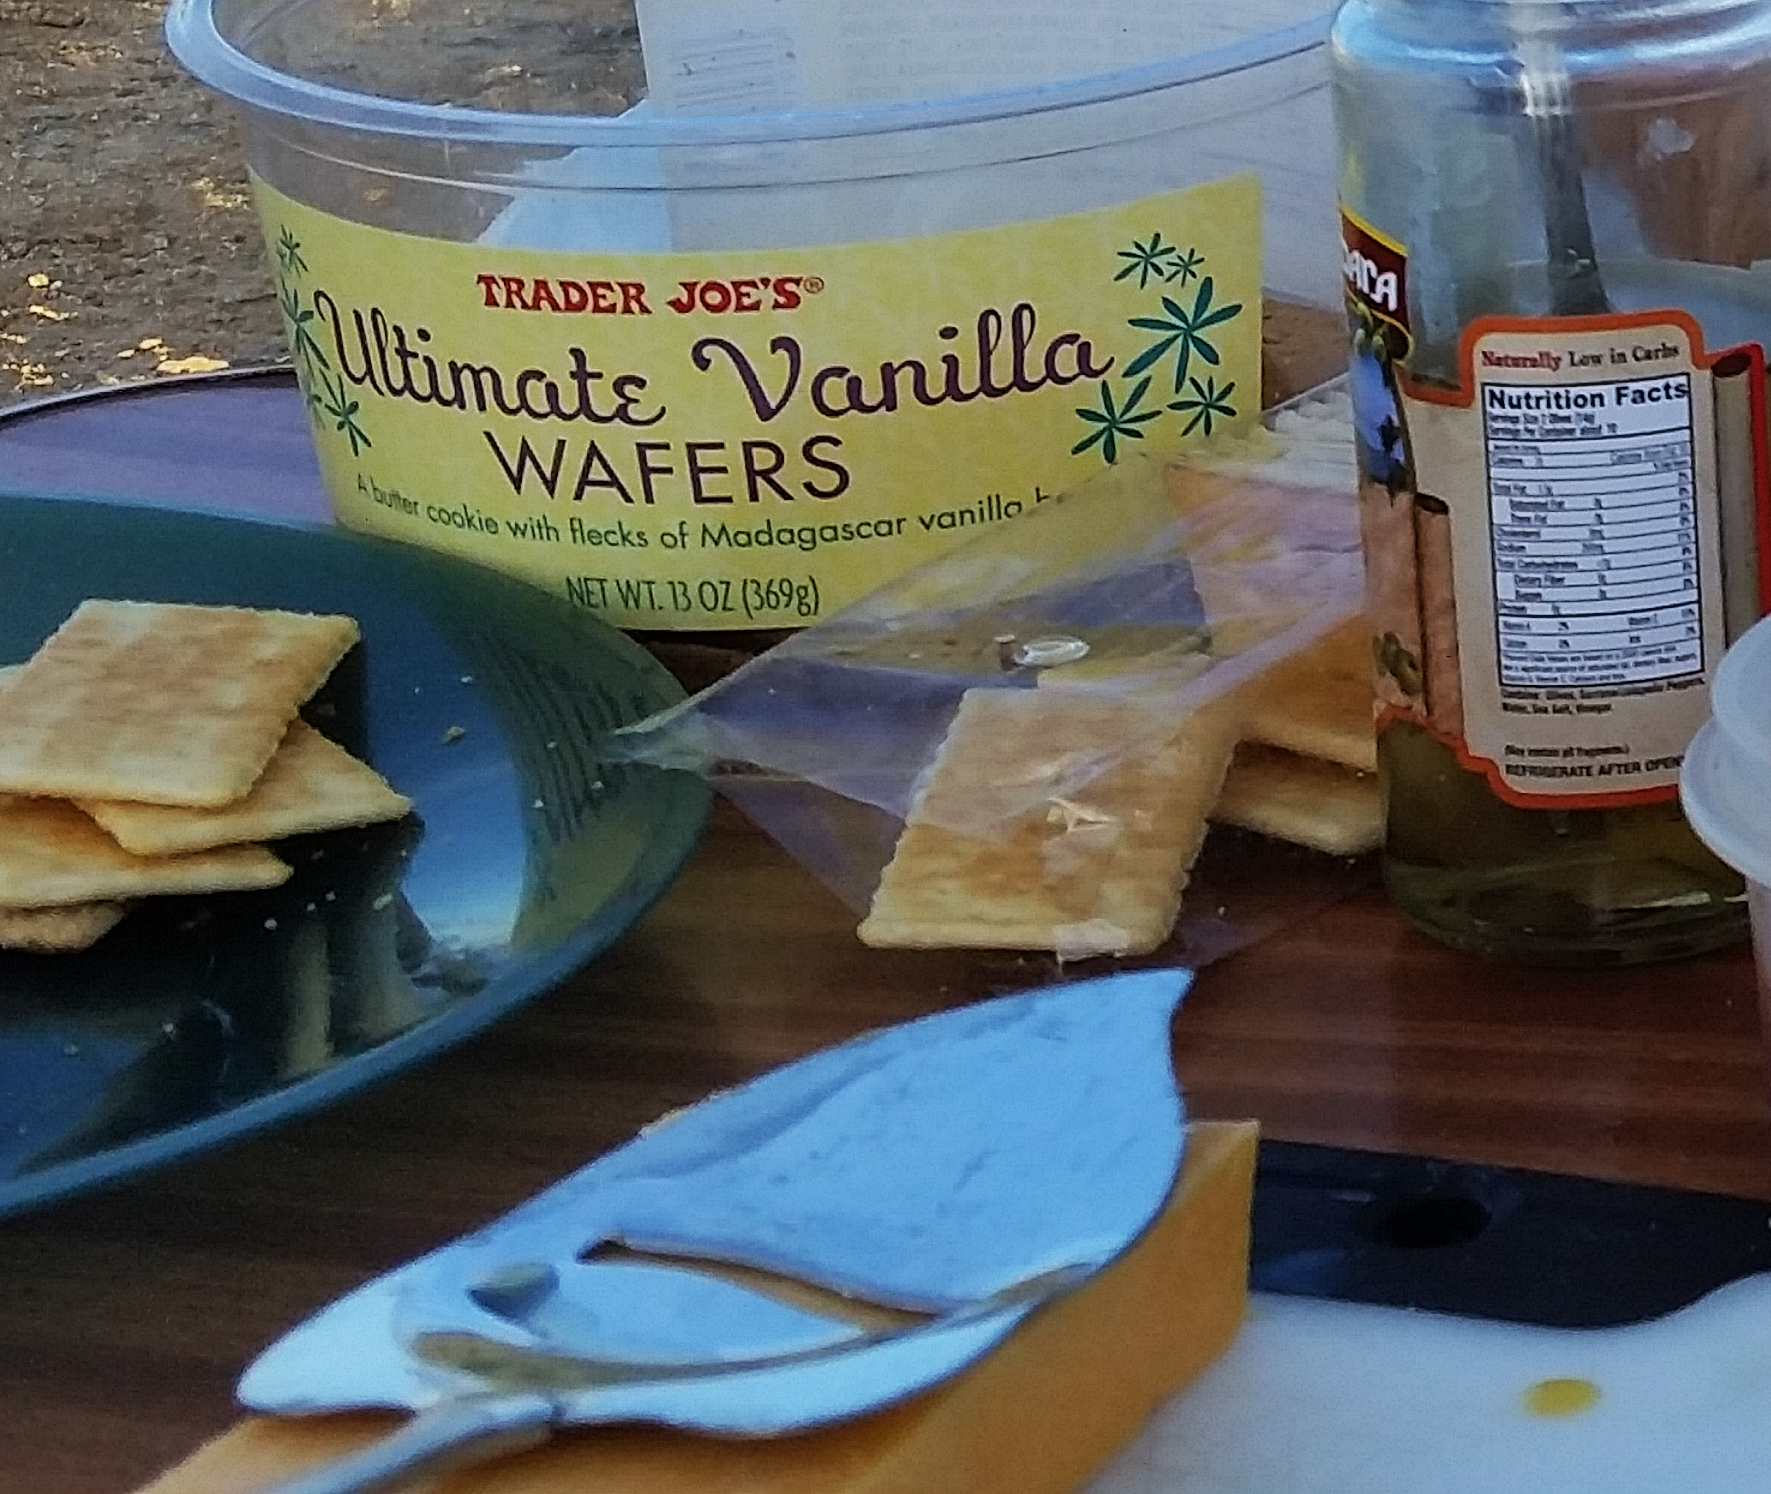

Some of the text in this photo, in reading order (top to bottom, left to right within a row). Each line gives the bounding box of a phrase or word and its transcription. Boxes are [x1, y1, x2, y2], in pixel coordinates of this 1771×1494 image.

[477, 274, 652, 315] TRADER
[313, 289, 1116, 427] Ultimate Vanilla
[1567, 350, 1604, 368] Low
[1610, 347, 1628, 365] in
[1631, 342, 1680, 363] Carbs
[1487, 381, 1691, 411] Nutrition Facts
[483, 430, 851, 507] WAFERS
[426, 503, 500, 536] cookie
[506, 515, 561, 543] with
[569, 517, 650, 549] flecks
[660, 521, 689, 550] of
[701, 517, 908, 552] Madagascar
[918, 494, 1023, 531] vanilla
[565, 575, 821, 620] NET WT. 13 OZ (369g)
